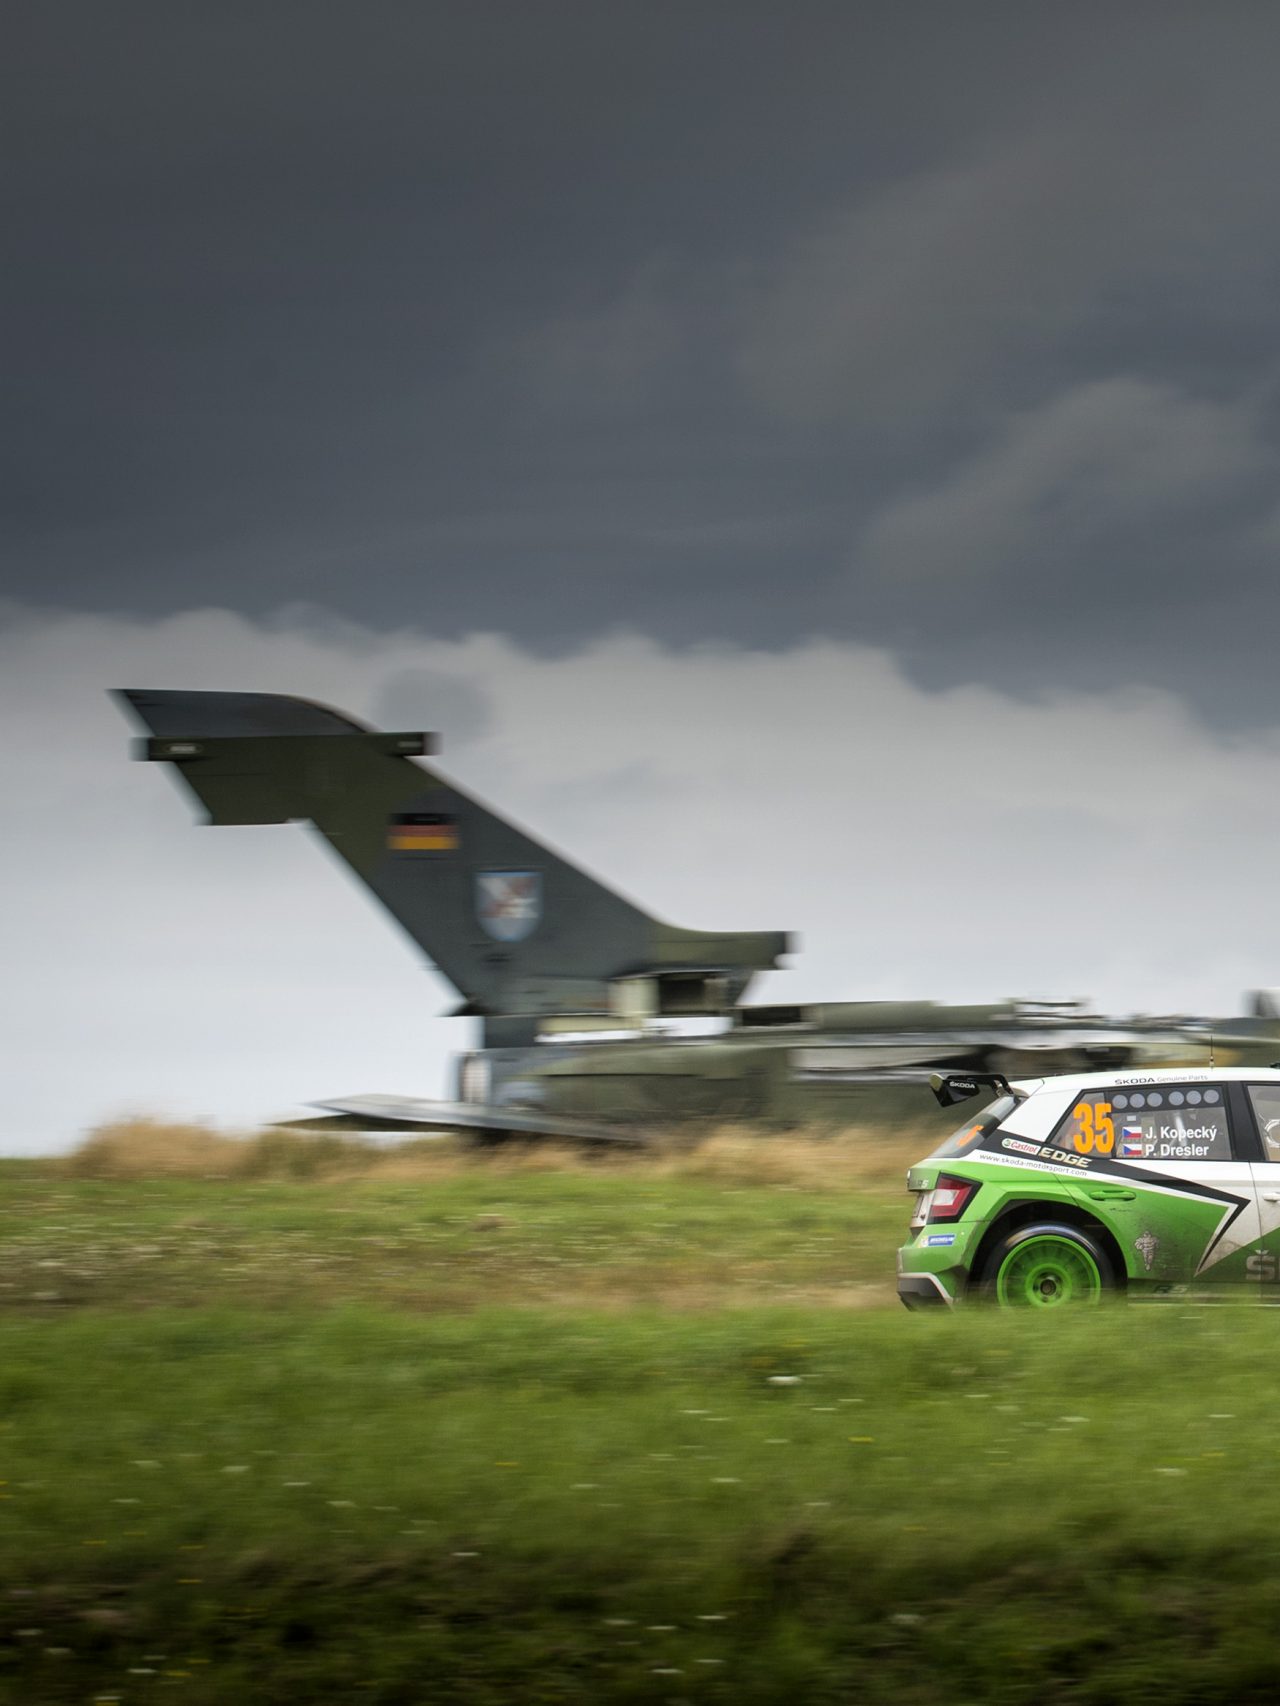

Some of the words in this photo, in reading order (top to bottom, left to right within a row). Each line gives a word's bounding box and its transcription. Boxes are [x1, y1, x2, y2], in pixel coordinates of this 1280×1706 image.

[1073, 1102, 1115, 1154] 35
[1145, 1129, 1157, 1139] J.
[1160, 1125, 1217, 1141] Kopecký
[1011, 1140, 1038, 1153] Castrol
[1038, 1146, 1092, 1168] EDGE
[1145, 1144, 1157, 1156] P.
[1160, 1144, 1209, 1157] Dresler
